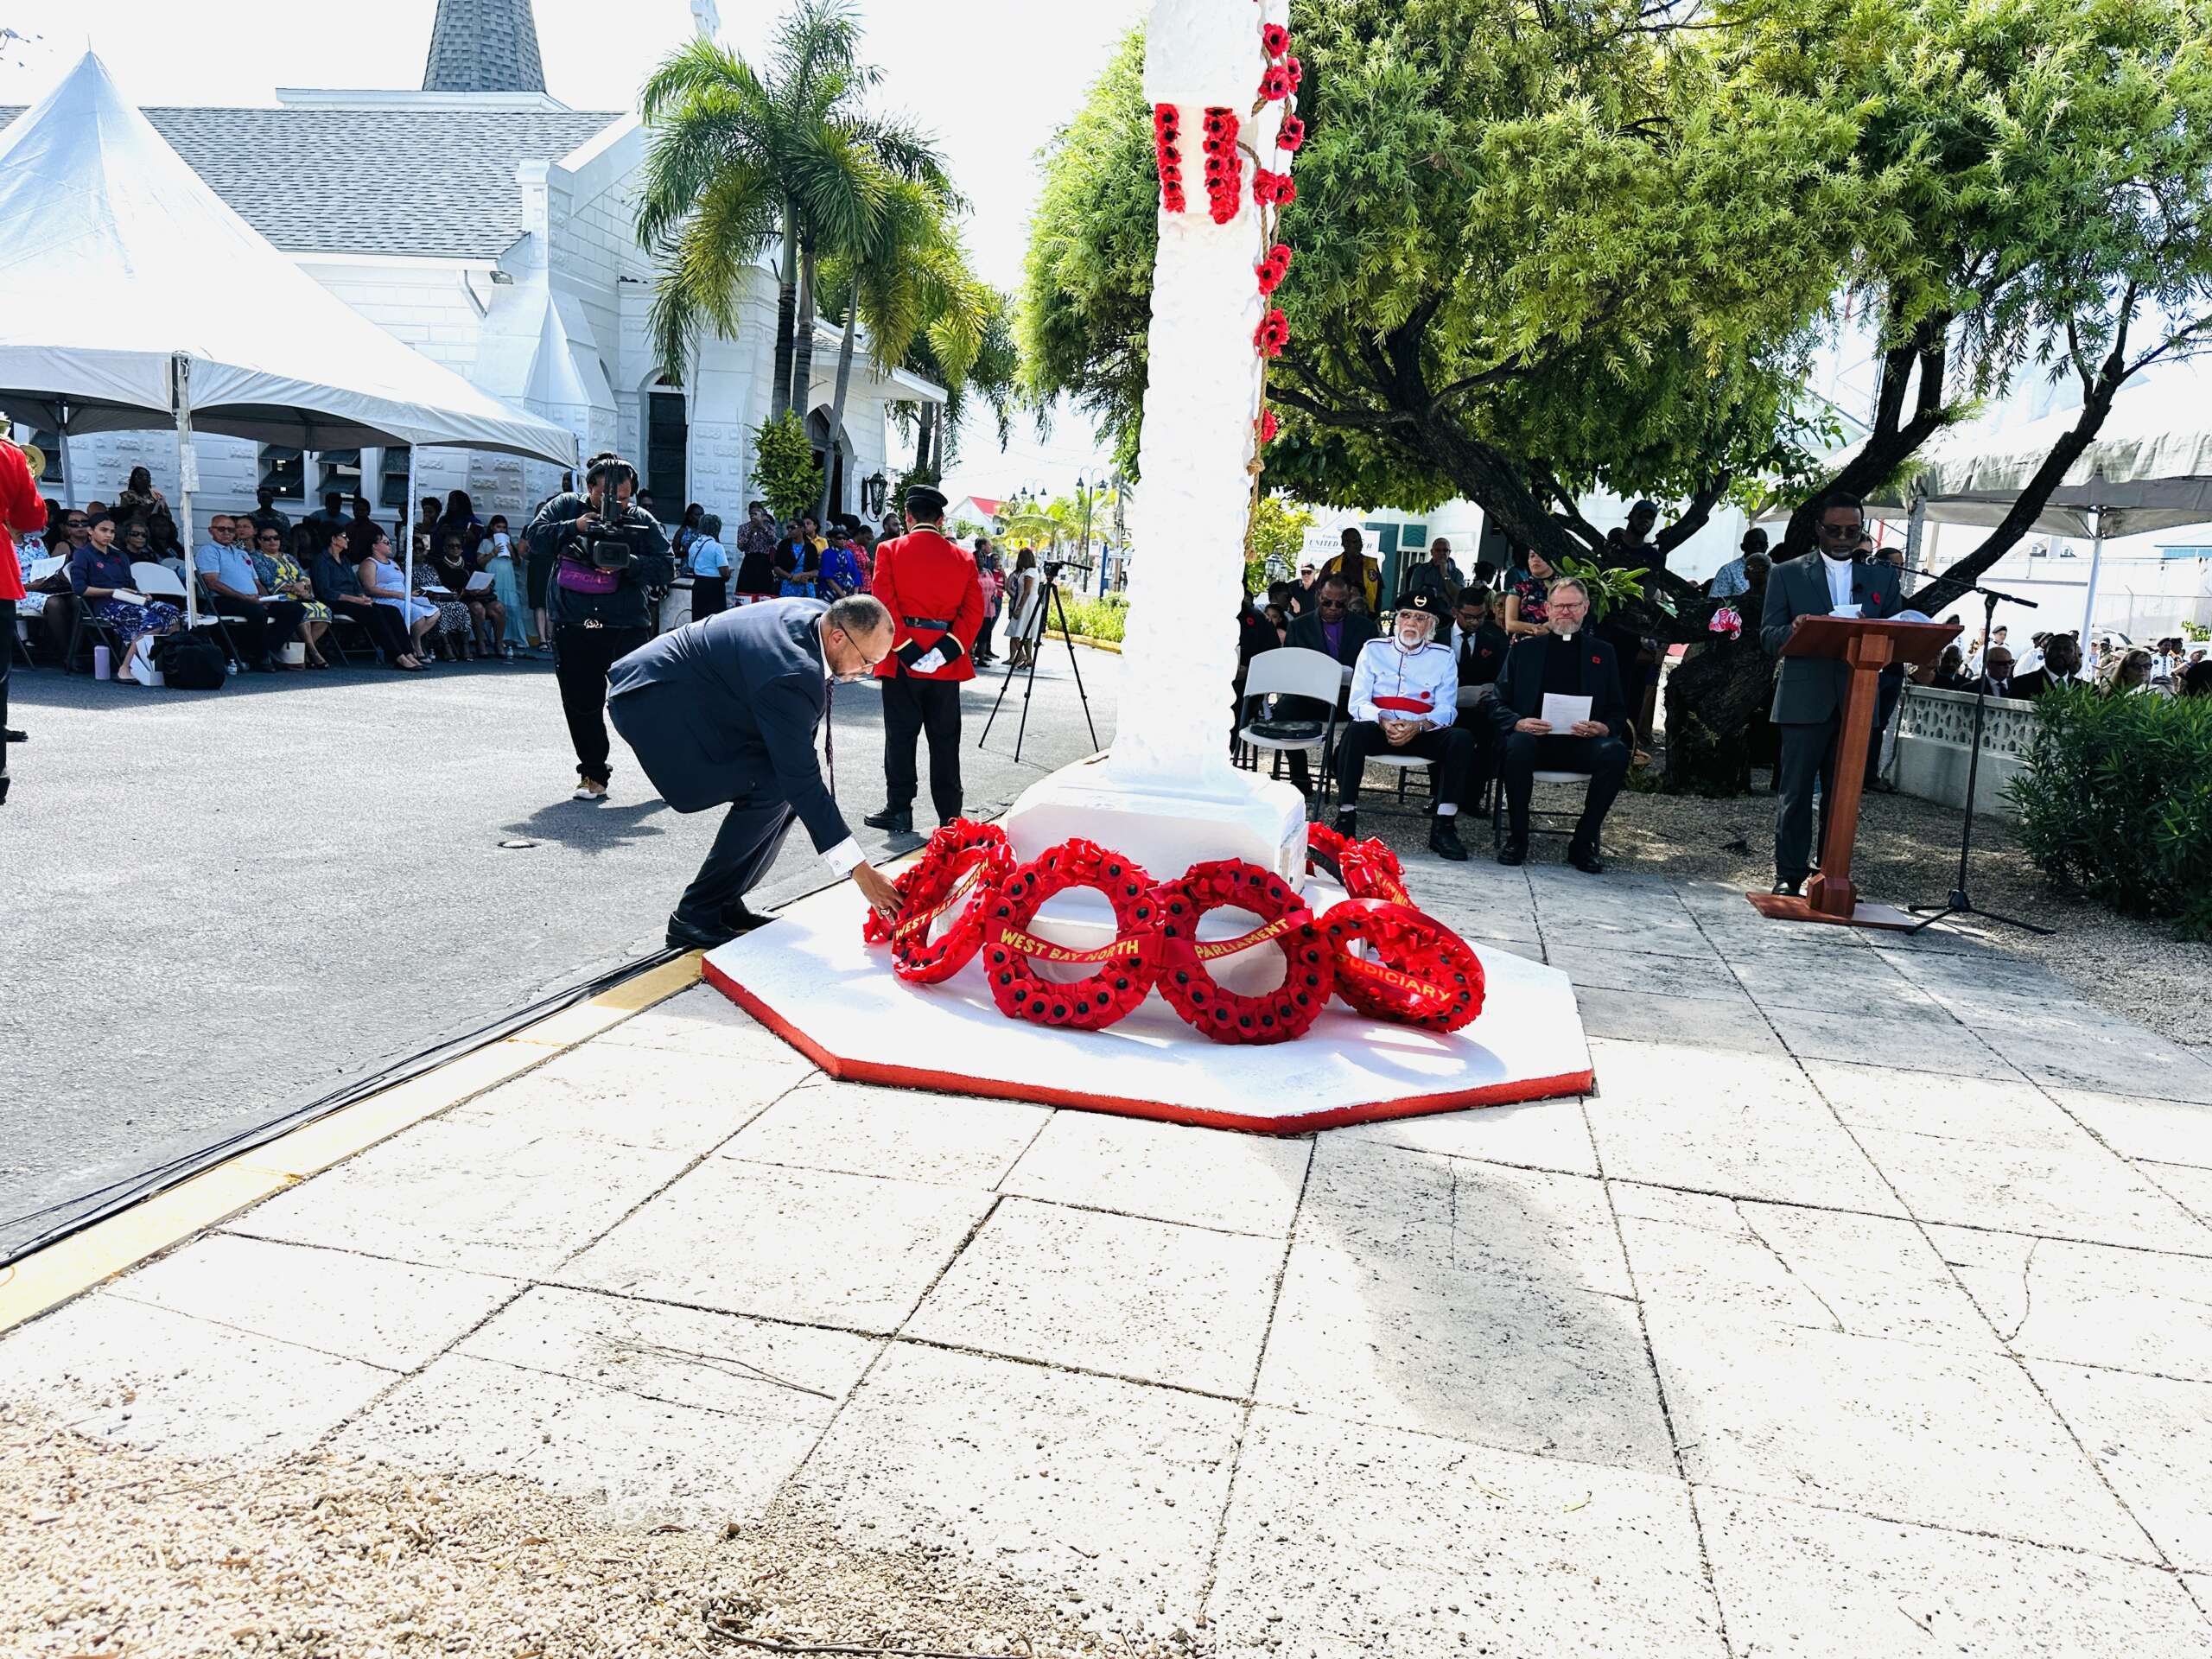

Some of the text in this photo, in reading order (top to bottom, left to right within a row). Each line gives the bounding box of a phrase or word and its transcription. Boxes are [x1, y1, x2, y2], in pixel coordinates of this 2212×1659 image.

[1308, 539, 1338, 548] UNITED
[895, 857, 989, 940] WEST BAY SOUTH
[1000, 927, 1139, 962] WEST BAY NORTH
[1194, 918, 1290, 959] PARLIAMENT
